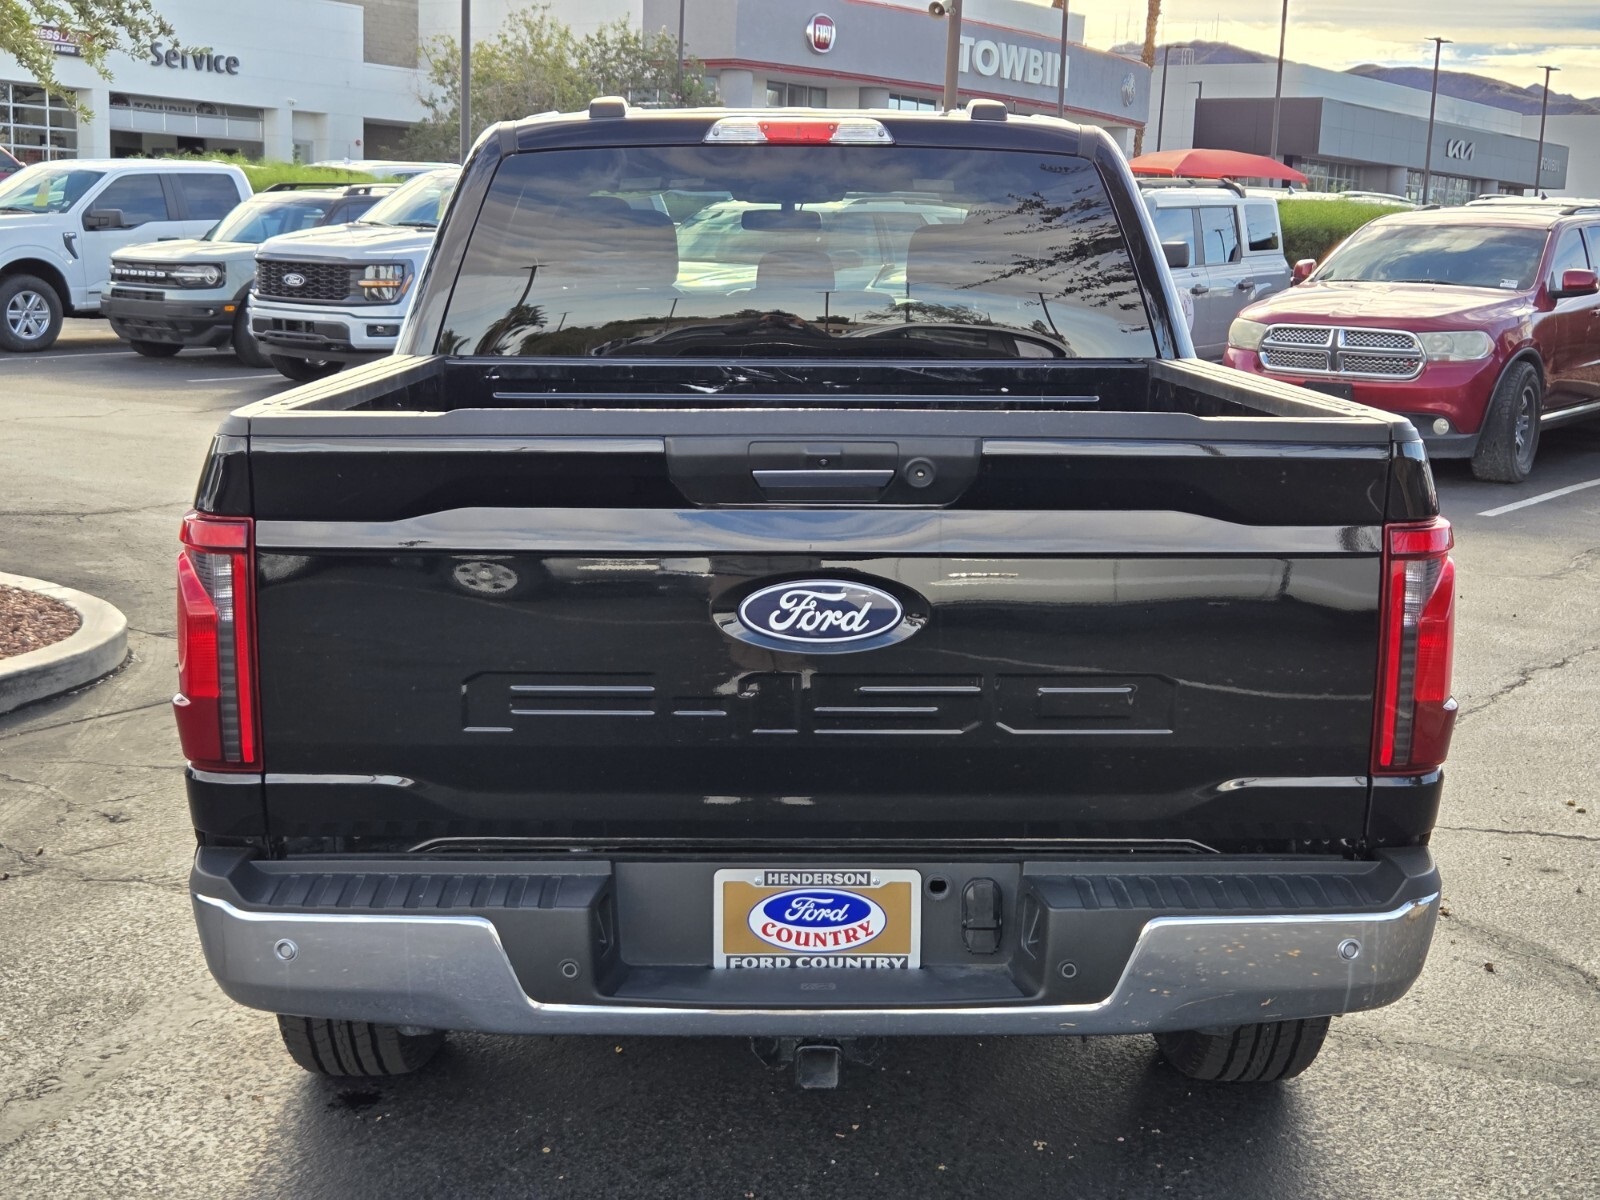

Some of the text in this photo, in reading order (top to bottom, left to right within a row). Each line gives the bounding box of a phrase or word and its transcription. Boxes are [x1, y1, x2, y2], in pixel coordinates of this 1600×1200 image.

[815, 23, 832, 43] FIAT
[150, 42, 240, 75] Service
[958, 35, 1070, 89] TOWBIN
[768, 589, 873, 633] Ford
[461, 671, 1176, 735] F-150
[767, 872, 868, 885] HENDERSON
[784, 897, 850, 922] Ford
[761, 920, 874, 947] COUNTRY
[729, 957, 906, 969] FORD COUNTRY
